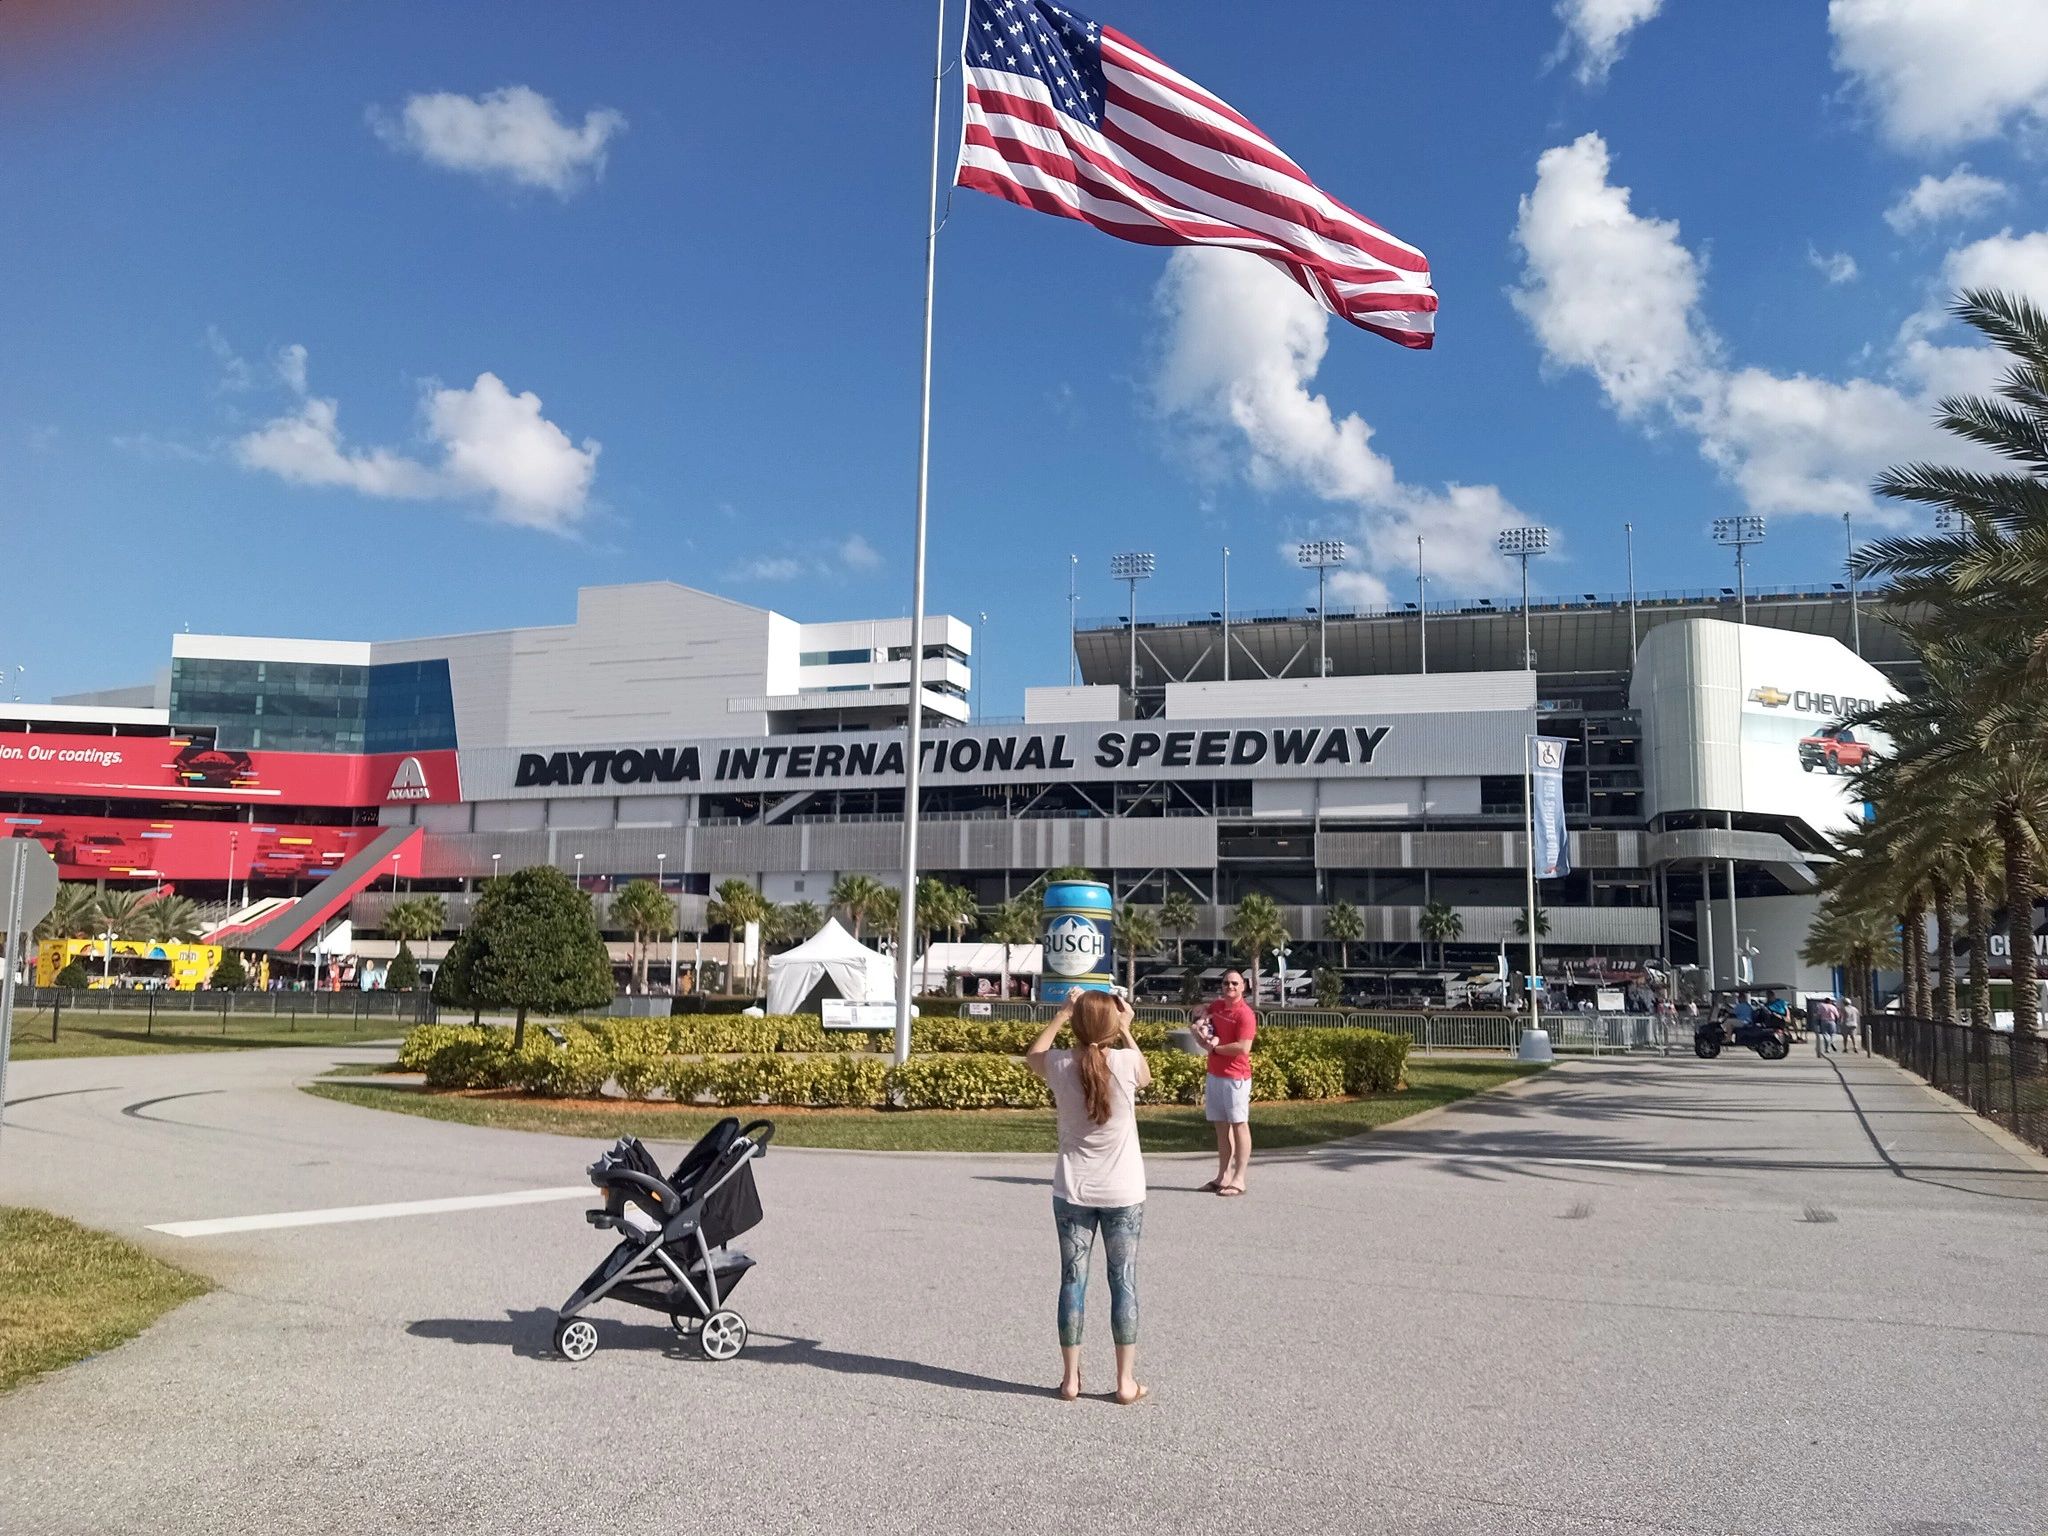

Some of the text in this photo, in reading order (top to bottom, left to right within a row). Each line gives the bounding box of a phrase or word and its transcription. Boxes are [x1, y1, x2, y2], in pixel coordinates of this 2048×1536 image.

[1794, 690, 1882, 717] CHEVRO
[28, 745, 56, 761] Our
[58, 748, 123, 767] coatings.
[514, 727, 1390, 786] DAYTONA INTERNATIONAL SPEEDWAY
[1044, 934, 1104, 956] BUSCH
